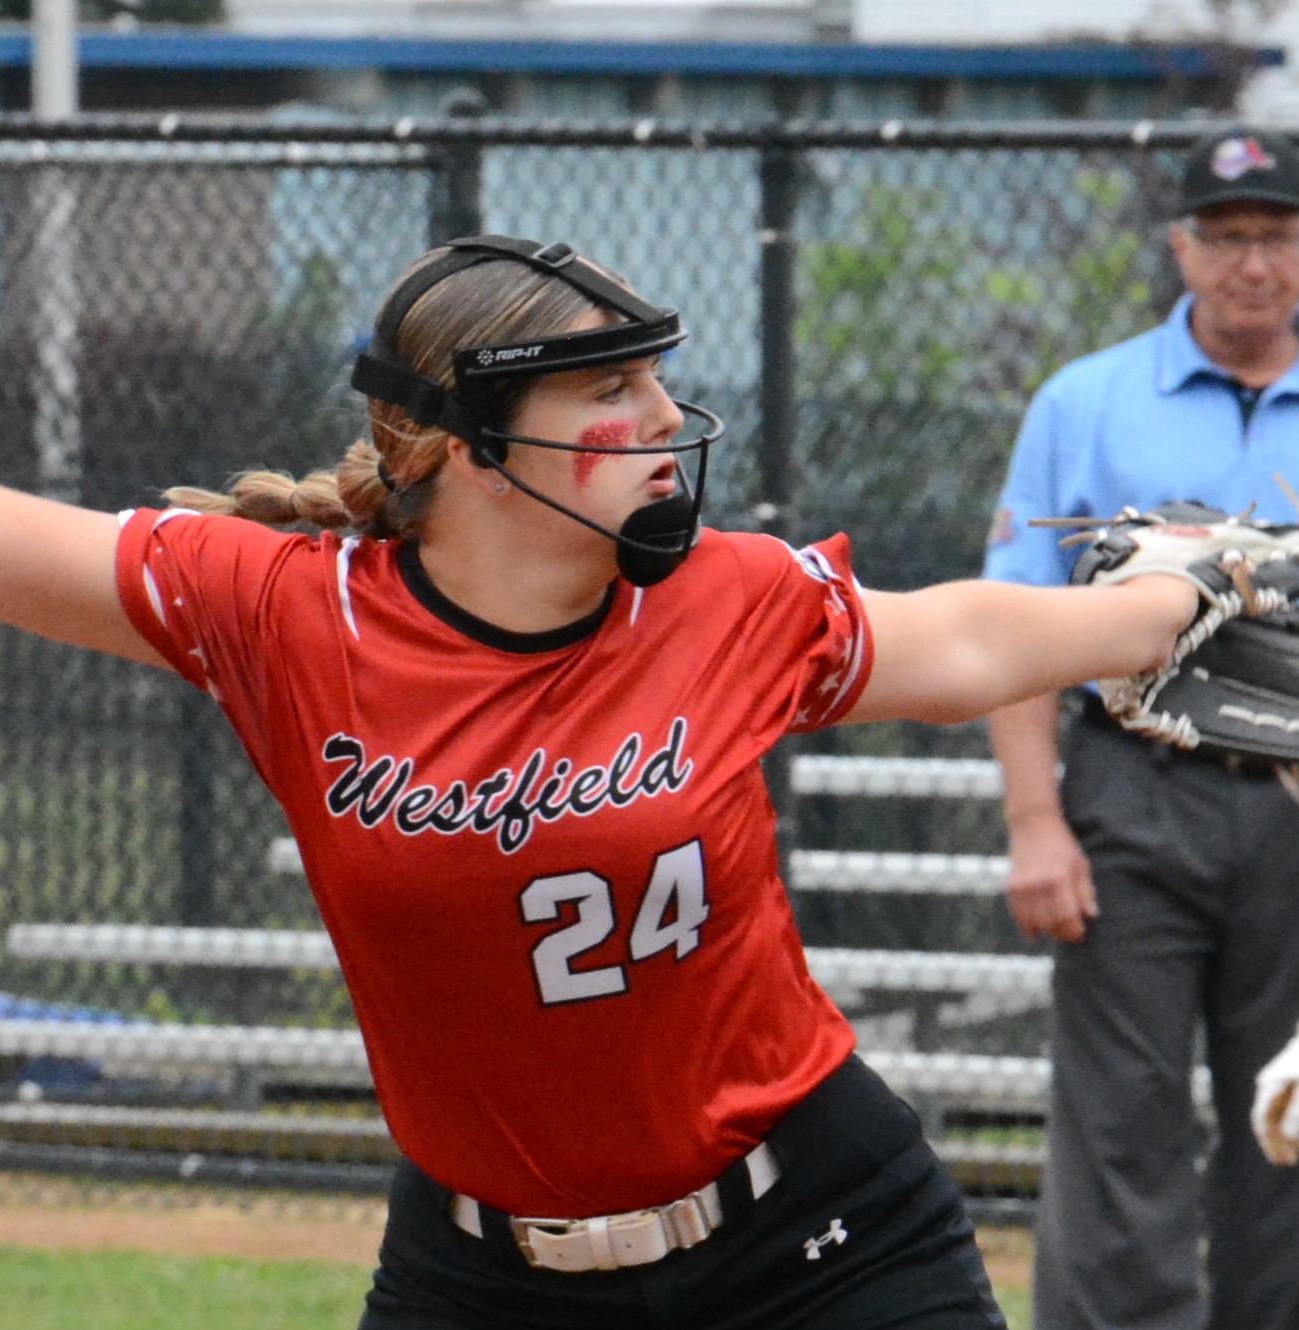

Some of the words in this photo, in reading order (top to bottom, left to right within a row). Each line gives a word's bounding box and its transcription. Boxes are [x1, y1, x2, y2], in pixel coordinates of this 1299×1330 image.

[495, 344, 544, 362] RIP-IT
[322, 717, 694, 855] Westfield
[518, 836, 709, 1008] 24
